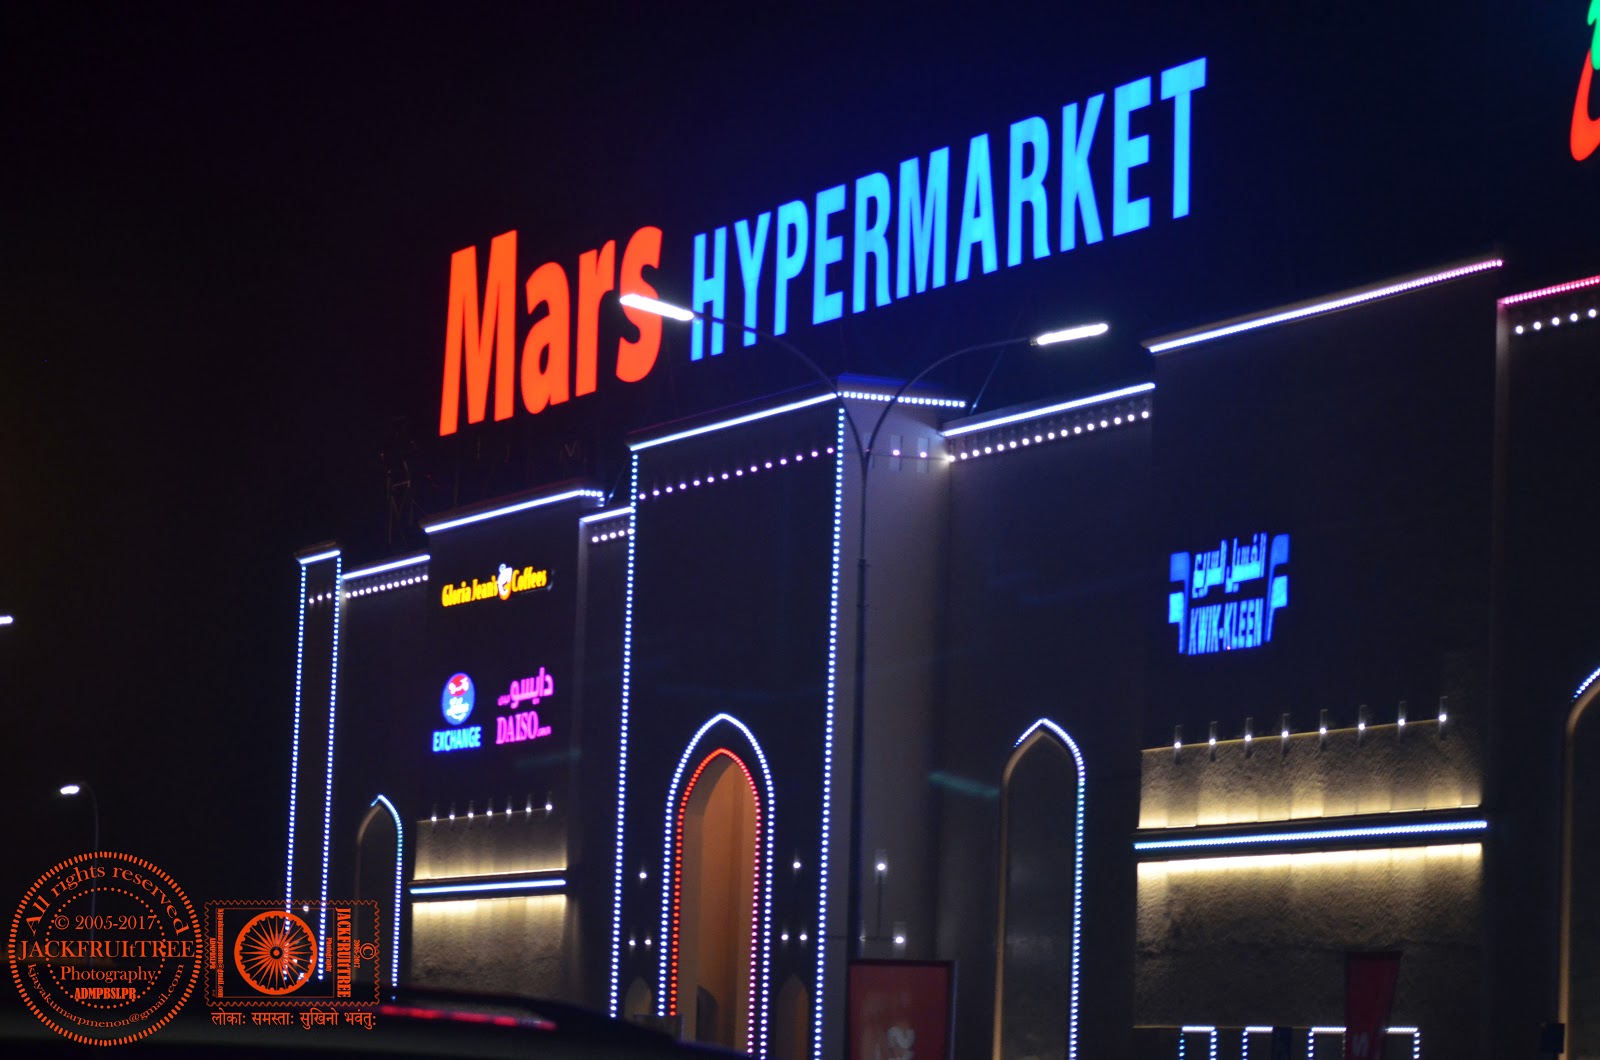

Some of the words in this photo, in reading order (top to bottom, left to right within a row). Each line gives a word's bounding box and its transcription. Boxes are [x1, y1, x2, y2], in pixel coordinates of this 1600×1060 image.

[439, 226, 663, 437] Mars
[690, 57, 1207, 361] HYPERMARKET
[441, 581, 472, 607] Gloria
[511, 566, 548, 593] Coffees
[1188, 598, 1264, 655] KWIK-KLEEN
[432, 726, 482, 752] EXCHANGE
[496, 711, 539, 744] DAISO
